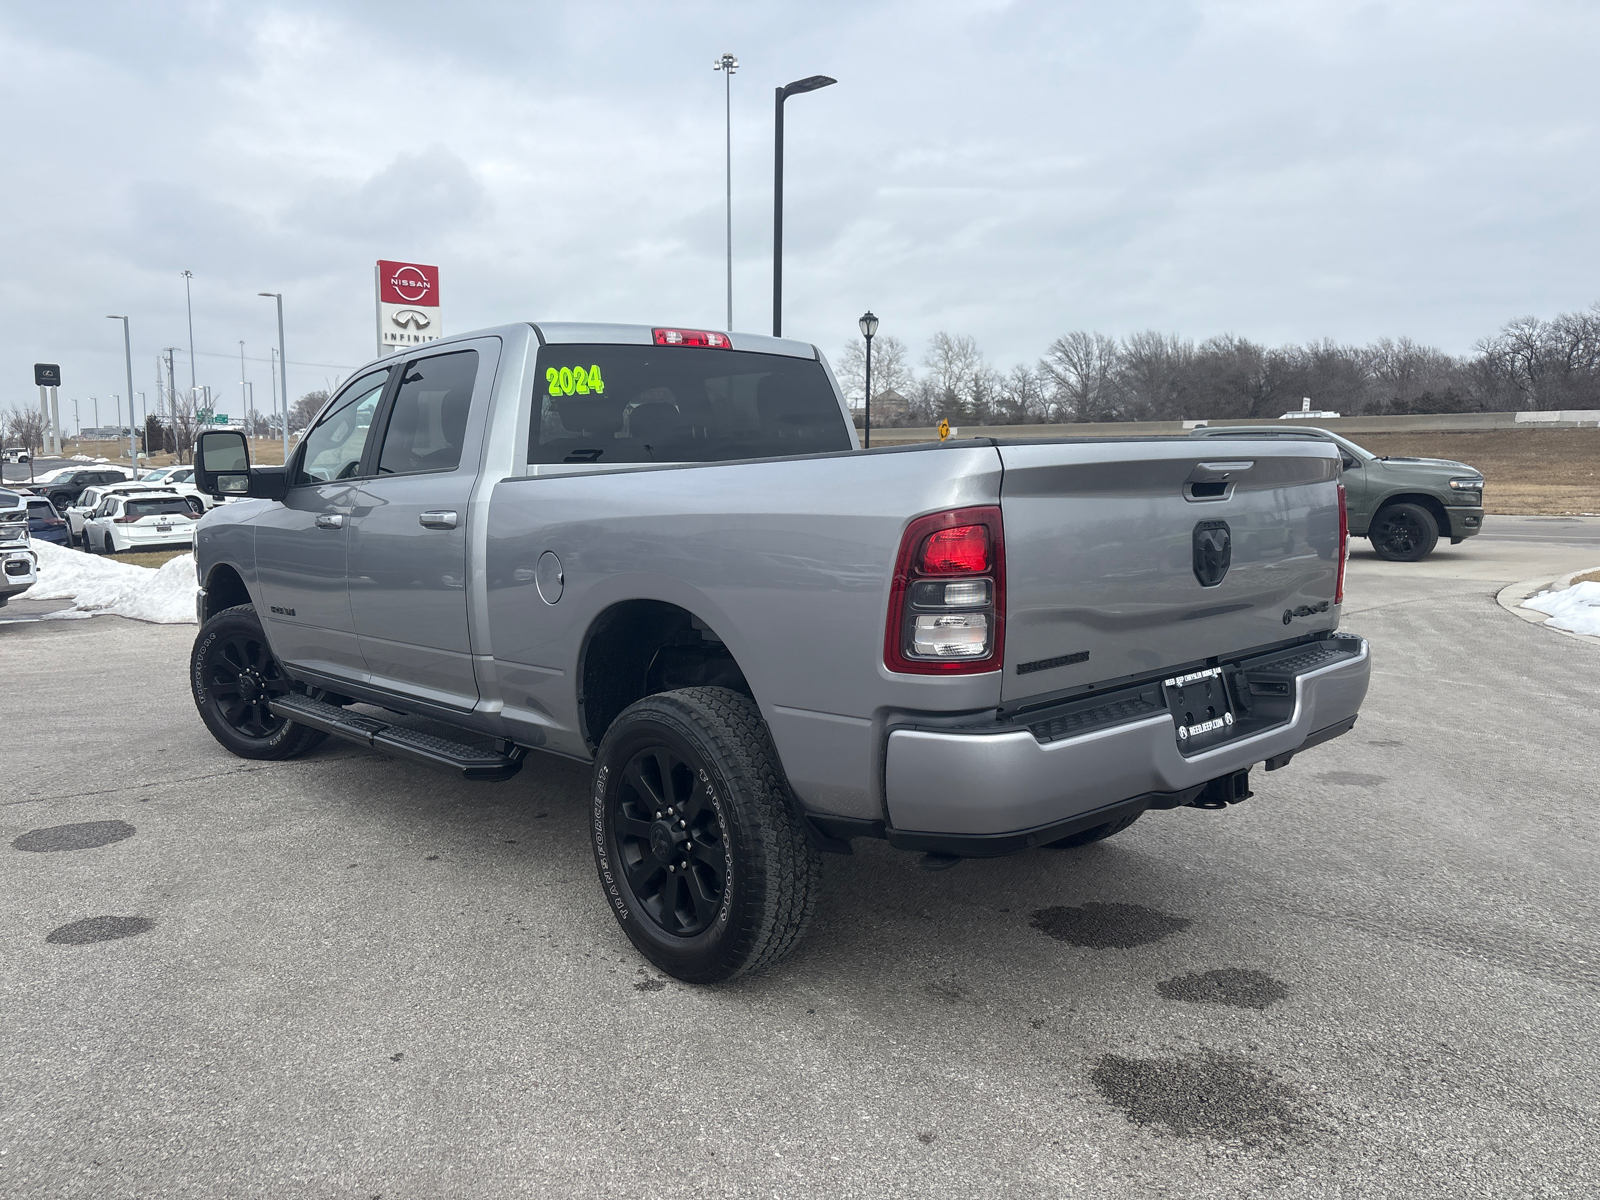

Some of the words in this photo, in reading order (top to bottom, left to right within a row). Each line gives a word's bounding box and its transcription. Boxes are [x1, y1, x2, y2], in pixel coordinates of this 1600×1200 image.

[390, 278, 431, 289] NISSAN
[546, 364, 605, 397] 2024
[594, 796, 630, 920] TRANSFORCE
